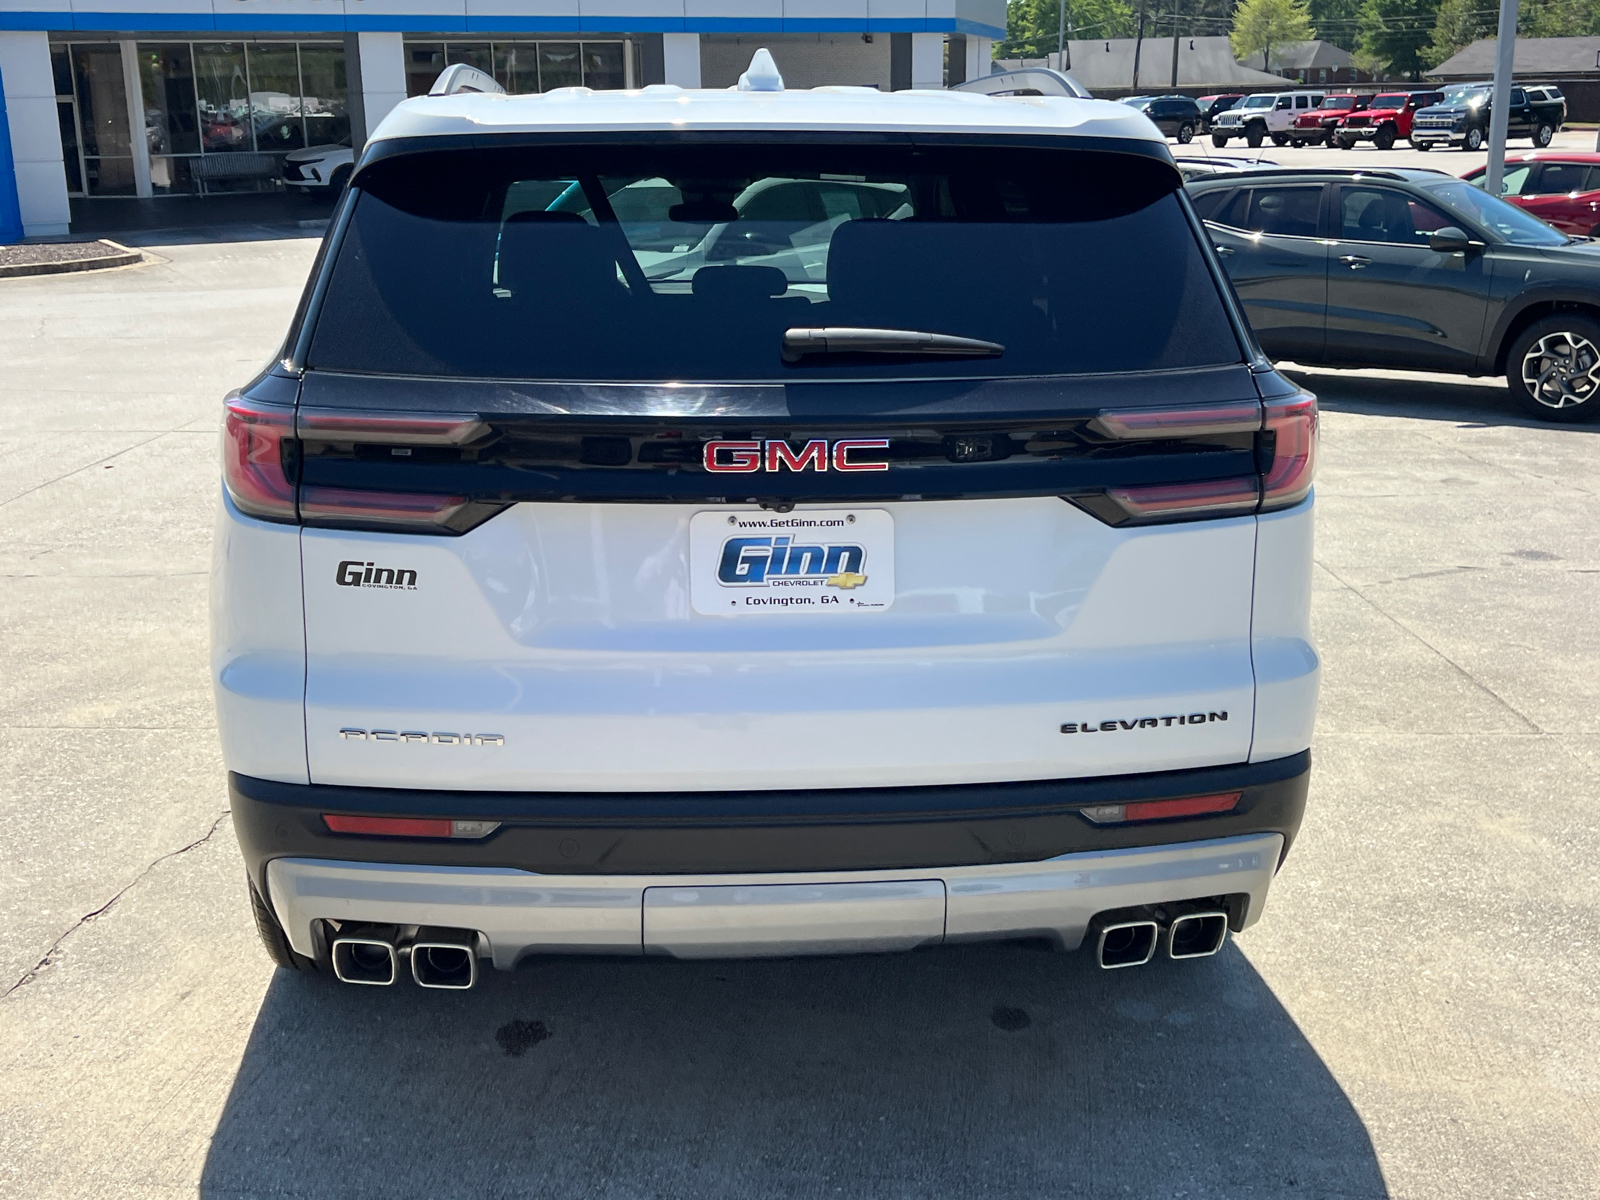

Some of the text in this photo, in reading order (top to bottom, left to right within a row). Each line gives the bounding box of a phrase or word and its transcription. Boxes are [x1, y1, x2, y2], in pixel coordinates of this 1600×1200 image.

[703, 439, 890, 473] GMC
[738, 518, 845, 528] www.GetGinn.com
[717, 535, 866, 585] Ginn
[336, 560, 417, 587] Ginn
[745, 595, 840, 607] Covington, GA
[1060, 711, 1229, 734] ELEVATION
[339, 727, 505, 746] ACADIA
